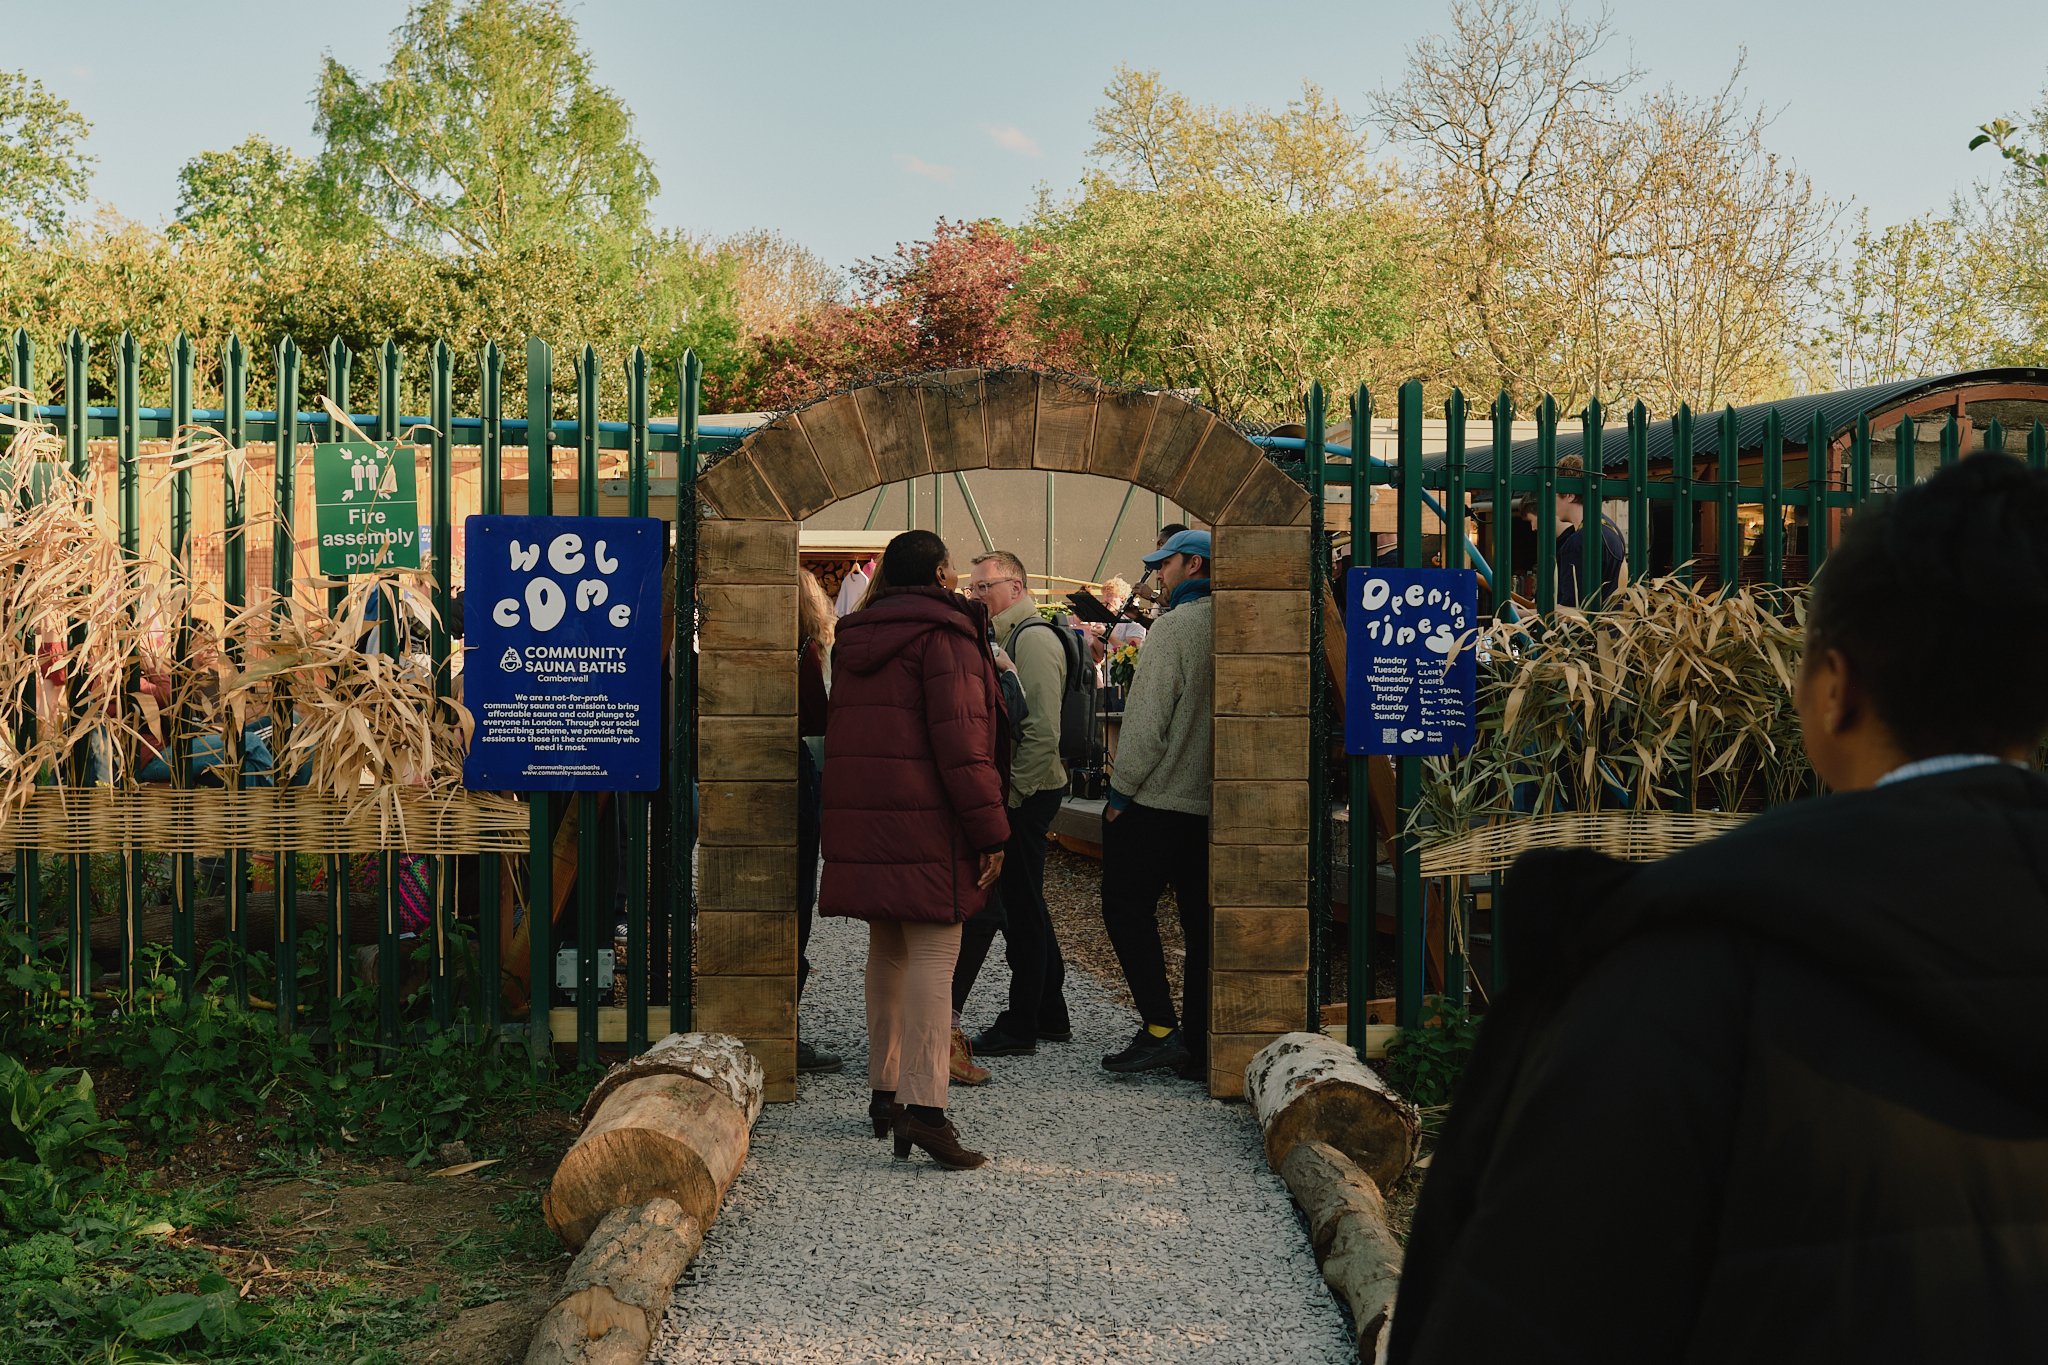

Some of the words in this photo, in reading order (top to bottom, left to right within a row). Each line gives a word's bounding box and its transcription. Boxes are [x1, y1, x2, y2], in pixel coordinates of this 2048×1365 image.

[348, 509, 386, 524] Fire
[323, 528, 414, 547] assembly
[346, 549, 394, 569] point
[524, 646, 626, 659] COMMUNITY
[1374, 657, 1407, 666] Monday
[524, 661, 575, 673] SAUNA
[579, 661, 626, 673] BATHS
[1373, 666, 1407, 675] Tuesday
[537, 674, 589, 683] Camberwell
[1367, 676, 1414, 684] Wednesday
[1371, 685, 1409, 694] Thursday
[552, 694, 608, 702] not-for-profit
[1377, 694, 1403, 703] Friday
[618, 703, 639, 711] bring
[1371, 703, 1409, 712] Saturday
[488, 710, 531, 718] affordable
[596, 711, 624, 719] plunge
[1374, 713, 1406, 721] Sunday
[566, 719, 599, 728] Through
[576, 736, 622, 744] community
